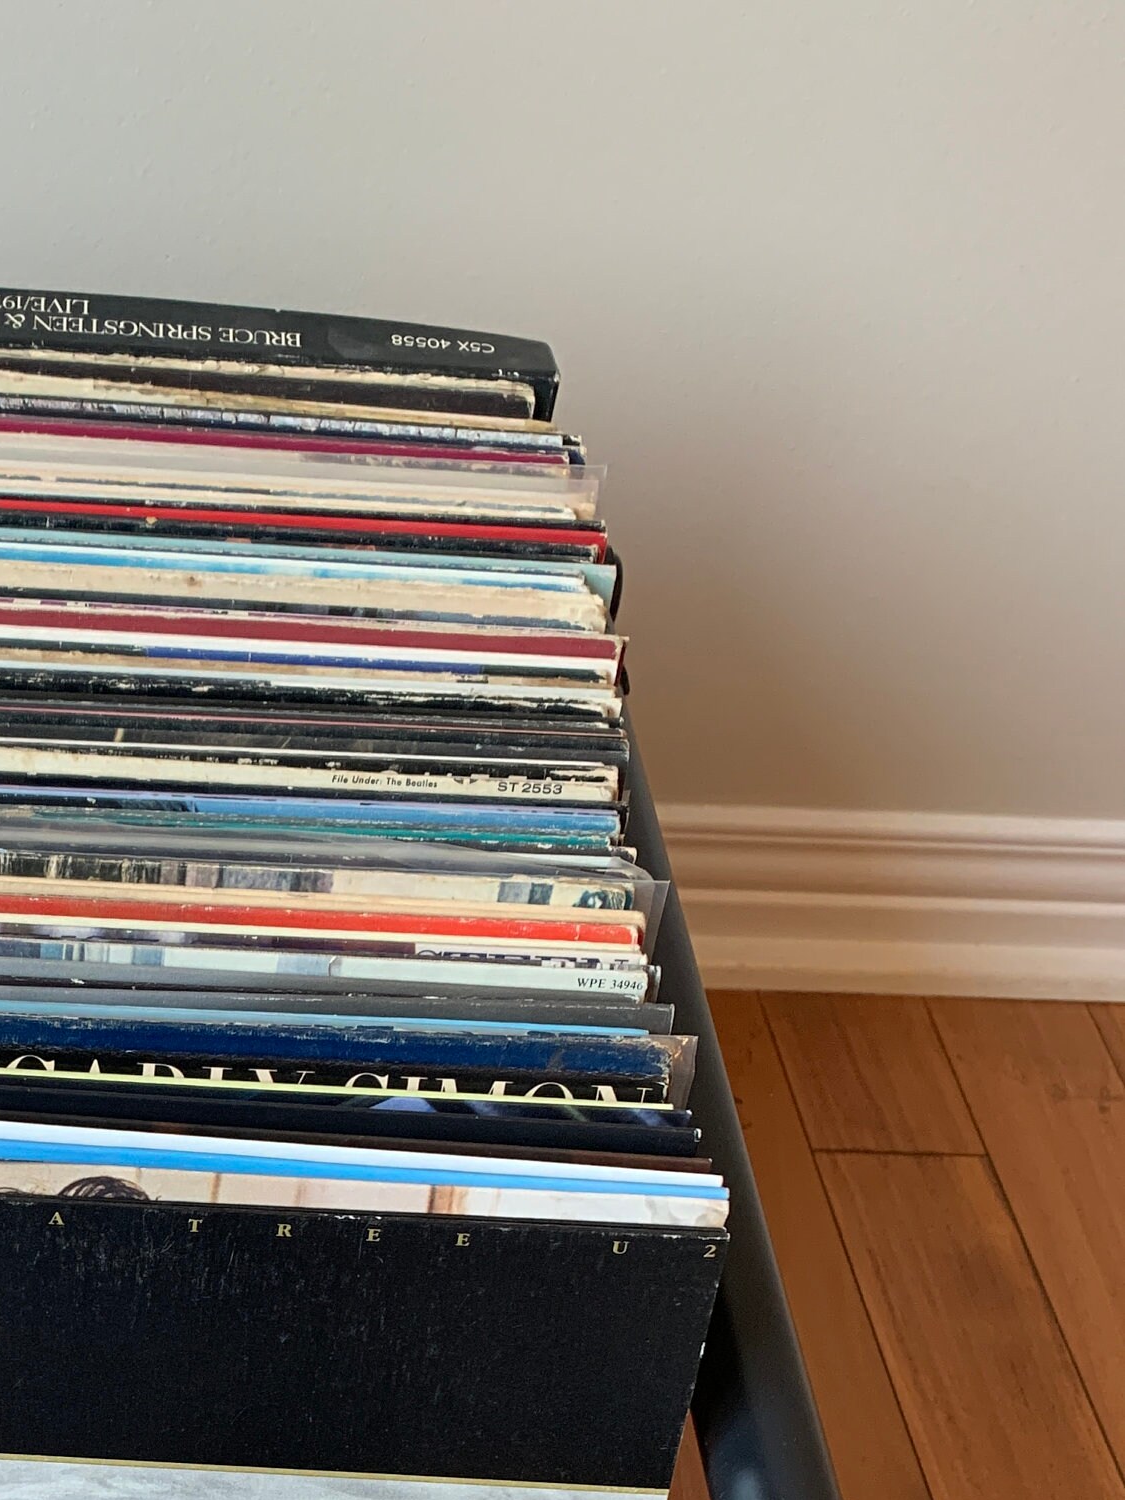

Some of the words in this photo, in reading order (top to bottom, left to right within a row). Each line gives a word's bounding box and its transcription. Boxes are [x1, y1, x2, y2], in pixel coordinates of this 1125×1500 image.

[5, 312, 25, 329] &
[33, 315, 212, 341] SPRINGSTEEN
[219, 327, 302, 347] BRUCE
[390, 334, 451, 350] 40558
[457, 340, 495, 353] C5X
[331, 774, 348, 785] File
[386, 776, 403, 787] The
[405, 778, 438, 789] Beatles
[497, 781, 518, 793] ST
[521, 783, 563, 795] 2553
[577, 977, 606, 989] WPE
[610, 979, 644, 990] 34946
[188, 1219, 470, 1248] TREE
